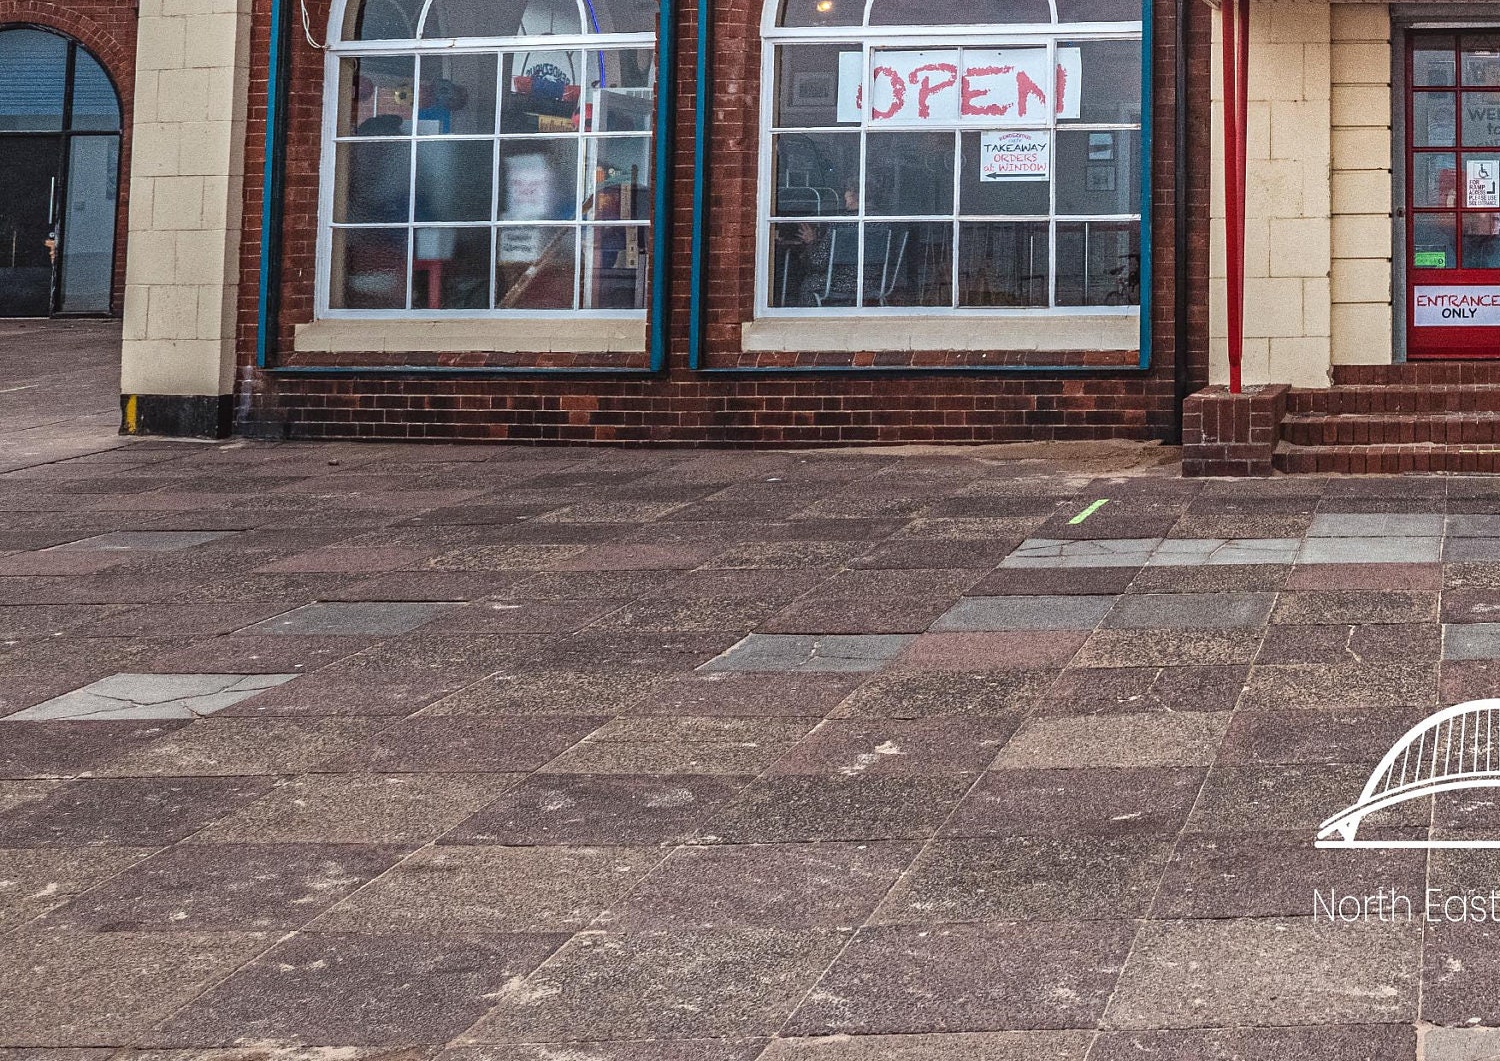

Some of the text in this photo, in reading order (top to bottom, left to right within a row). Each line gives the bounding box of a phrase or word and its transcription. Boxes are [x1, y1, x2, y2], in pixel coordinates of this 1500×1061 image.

[856, 63, 1067, 120] OPEN
[983, 142, 1047, 152] TAKEAWAY
[993, 153, 1038, 162] ORDERS
[983, 162, 1047, 172] at WINDOW
[1441, 307, 1478, 319] ONLY
